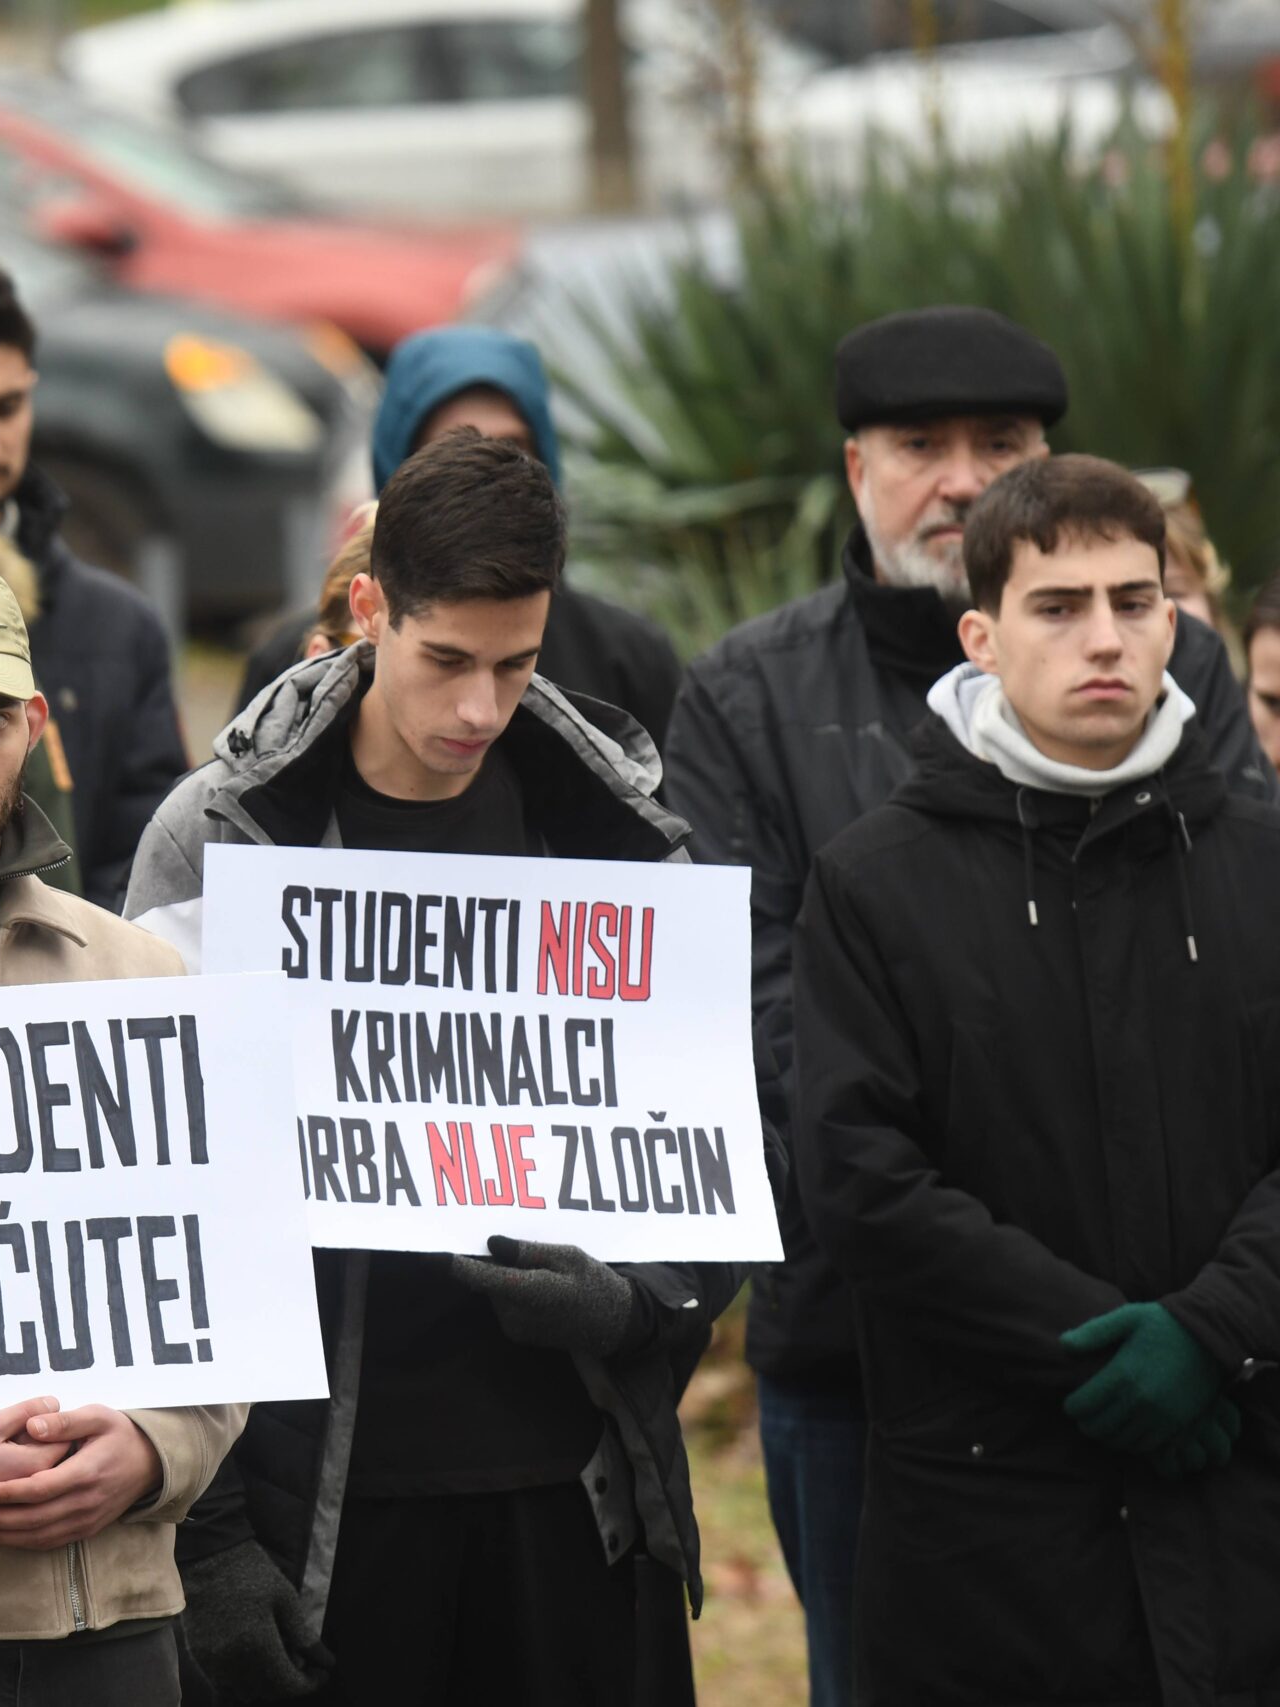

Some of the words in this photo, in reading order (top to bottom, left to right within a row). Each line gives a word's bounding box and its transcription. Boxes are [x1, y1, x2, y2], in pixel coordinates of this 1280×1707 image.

[282, 885, 520, 993] STUDENTI
[537, 900, 654, 1001] NISU
[331, 1009, 618, 1107] KRIMINALCI
[425, 1121, 546, 1210] NIJE
[551, 1110, 736, 1215] ZLOČIN
